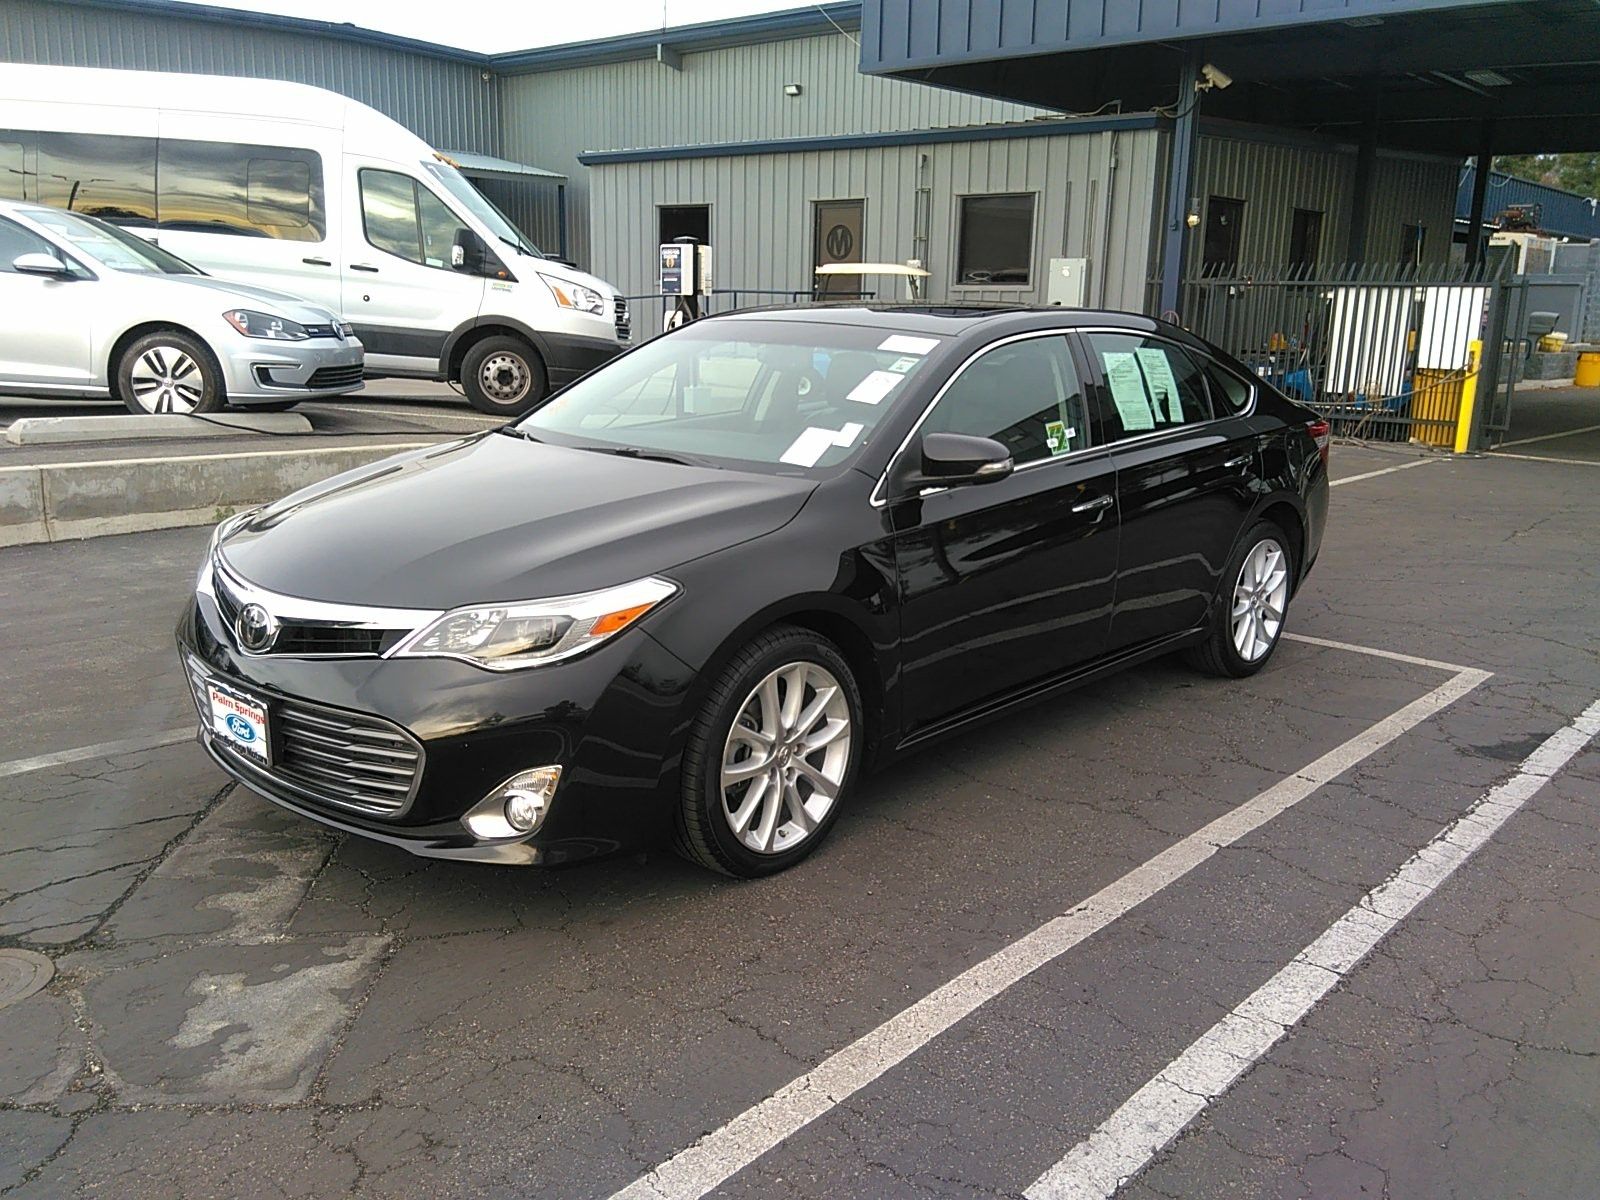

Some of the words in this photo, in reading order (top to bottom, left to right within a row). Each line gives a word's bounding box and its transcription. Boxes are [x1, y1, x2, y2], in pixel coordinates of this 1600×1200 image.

[829, 226, 851, 257] M
[212, 692, 234, 708] Palm
[234, 702, 266, 724] Springs
[231, 717, 251, 738] Ford
